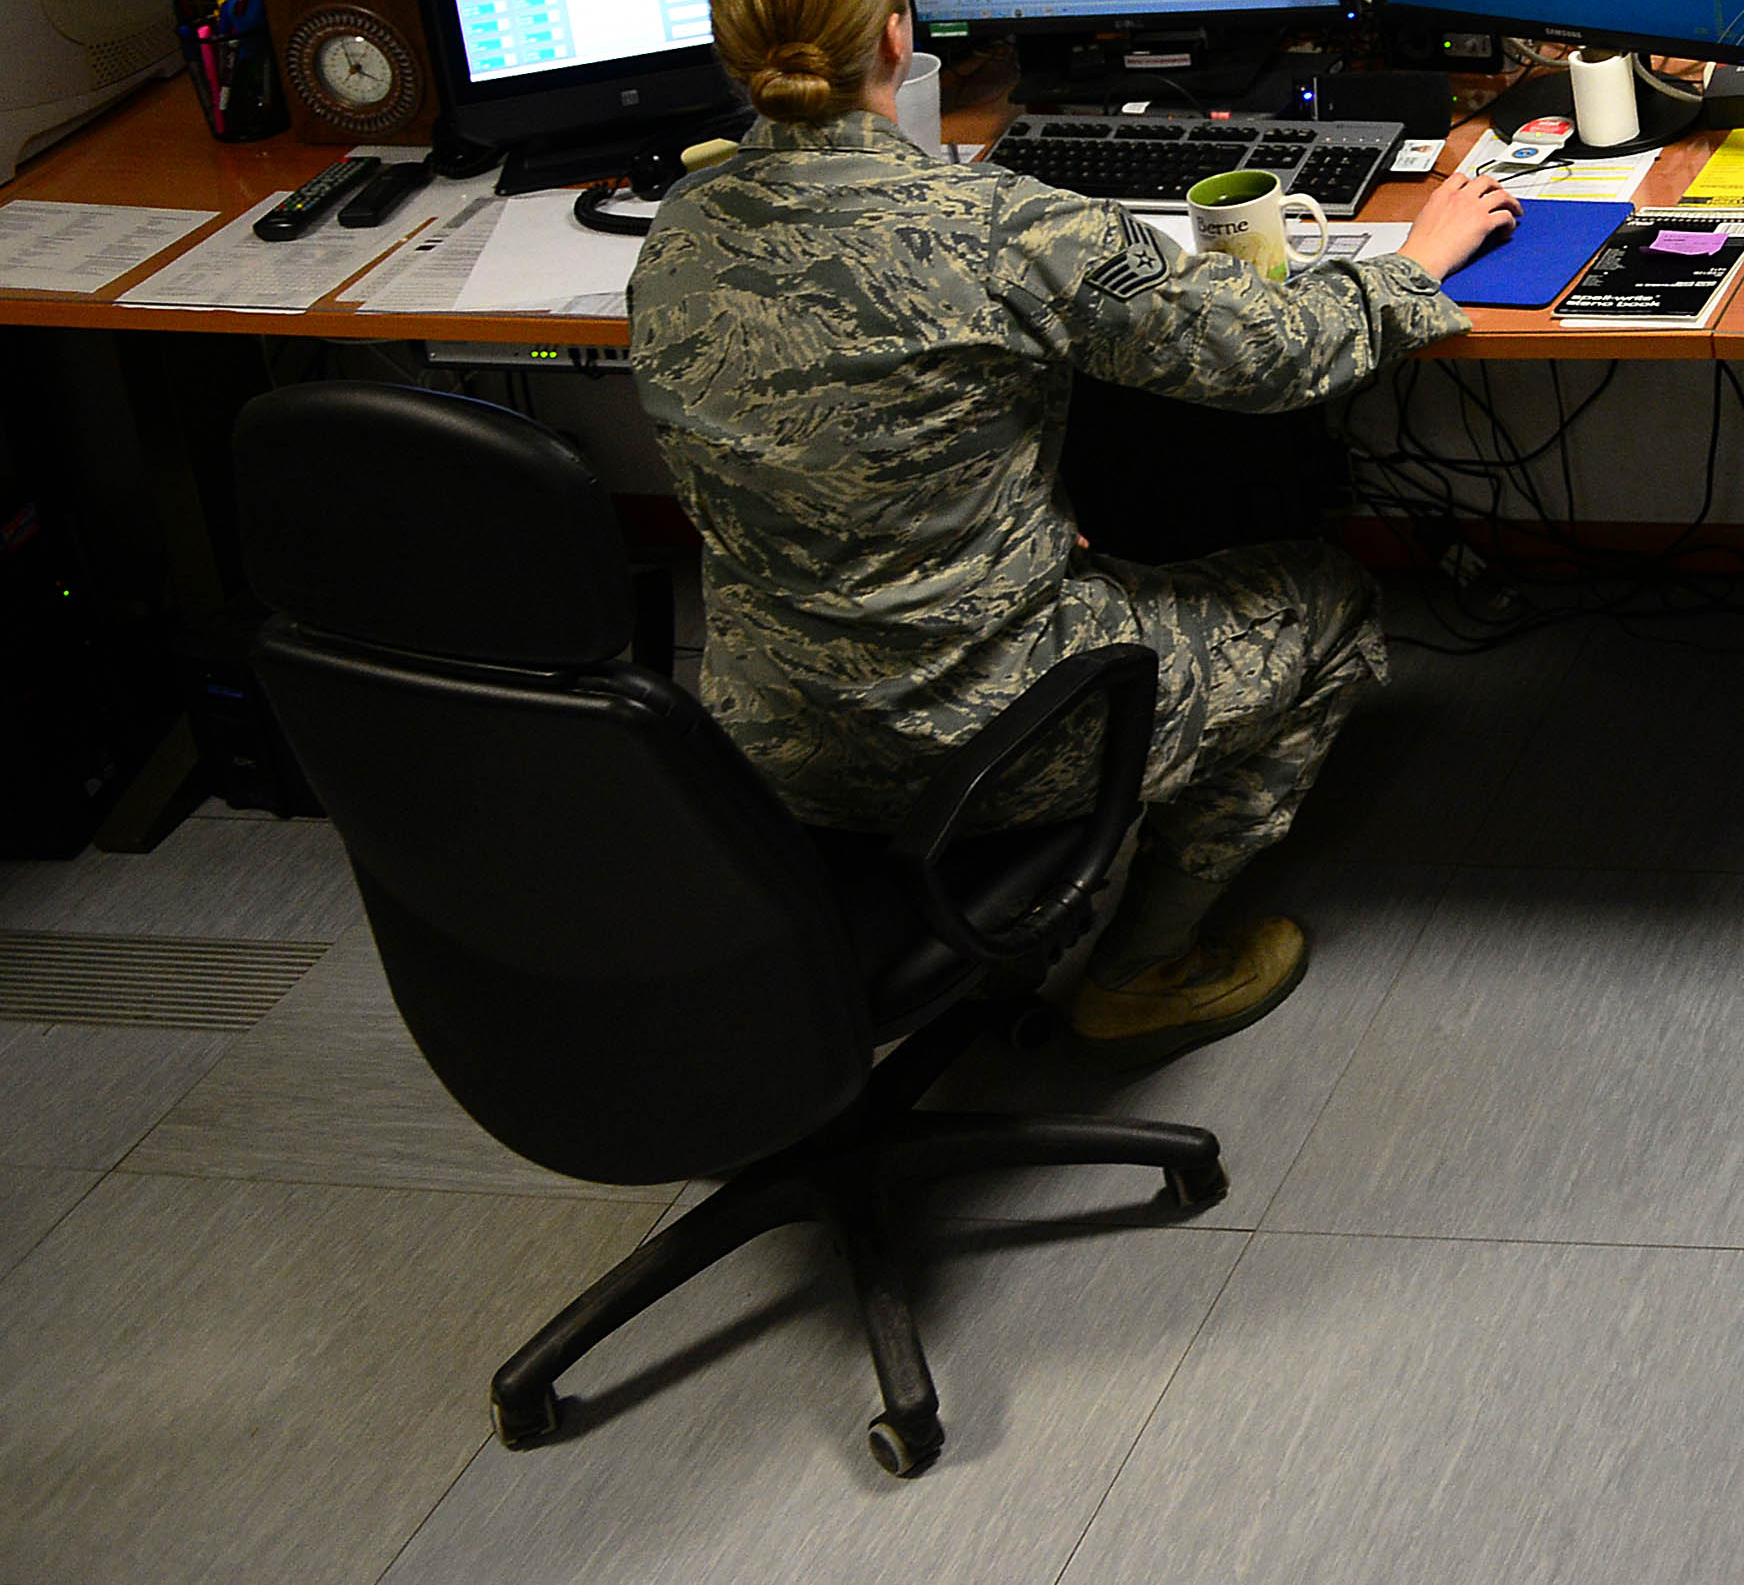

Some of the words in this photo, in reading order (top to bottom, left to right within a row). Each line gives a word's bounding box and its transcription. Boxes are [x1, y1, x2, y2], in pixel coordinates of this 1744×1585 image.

[1544, 26, 1584, 40] SAMSUNG
[1196, 215, 1250, 237] Berne
[1616, 299, 1661, 308] book
